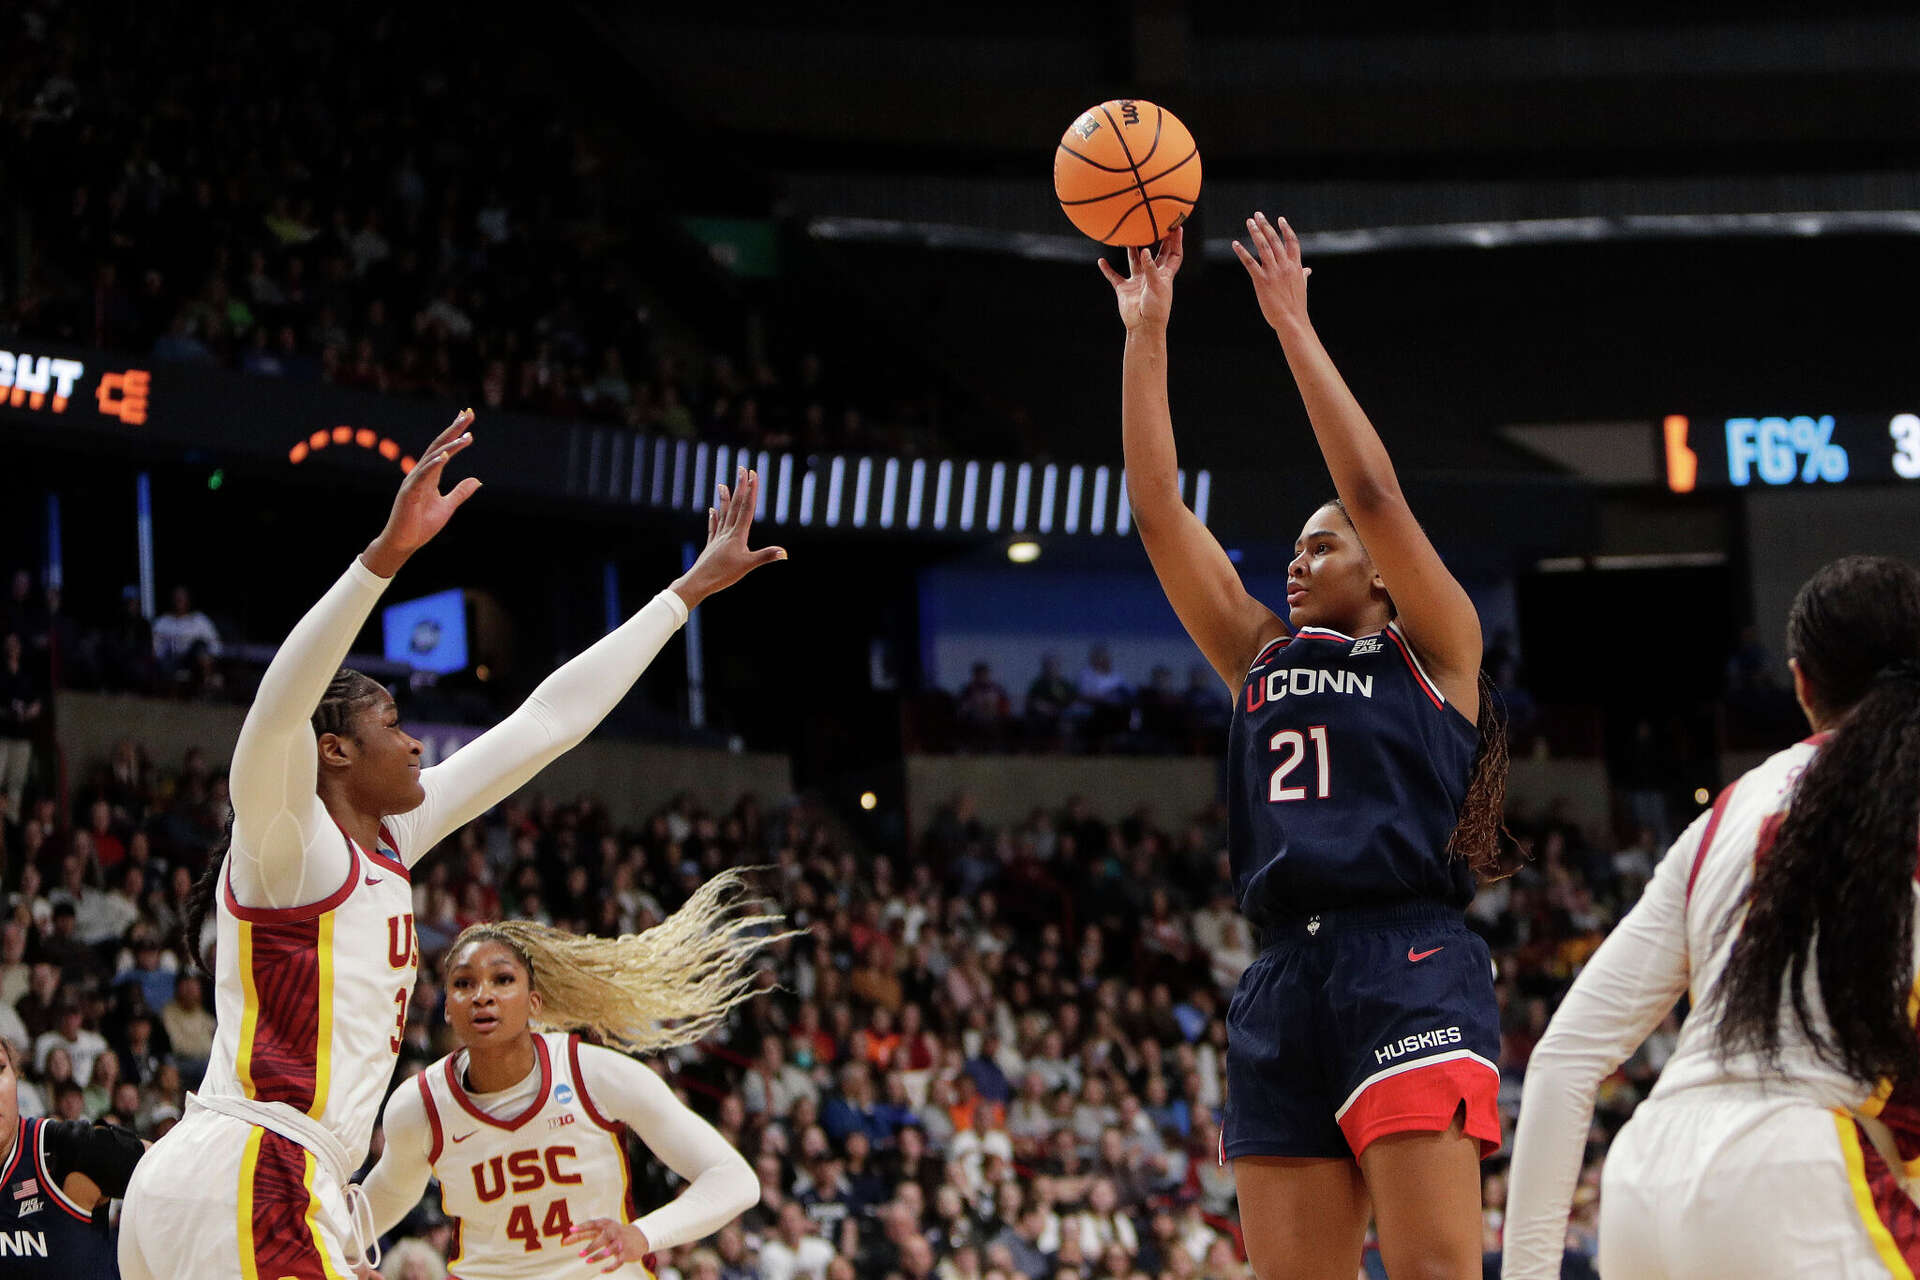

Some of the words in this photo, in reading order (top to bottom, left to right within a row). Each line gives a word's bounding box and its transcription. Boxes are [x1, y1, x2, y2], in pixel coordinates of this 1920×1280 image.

[1725, 415, 1849, 486] FG%
[1351, 644, 1384, 653] EAST
[1355, 639, 1378, 647] BIG
[1247, 668, 1373, 712] UCONN
[1268, 725, 1331, 802] 21
[1374, 1026, 1462, 1065] HUSKIES
[471, 1145, 584, 1205] USC
[506, 1197, 574, 1252] 44
